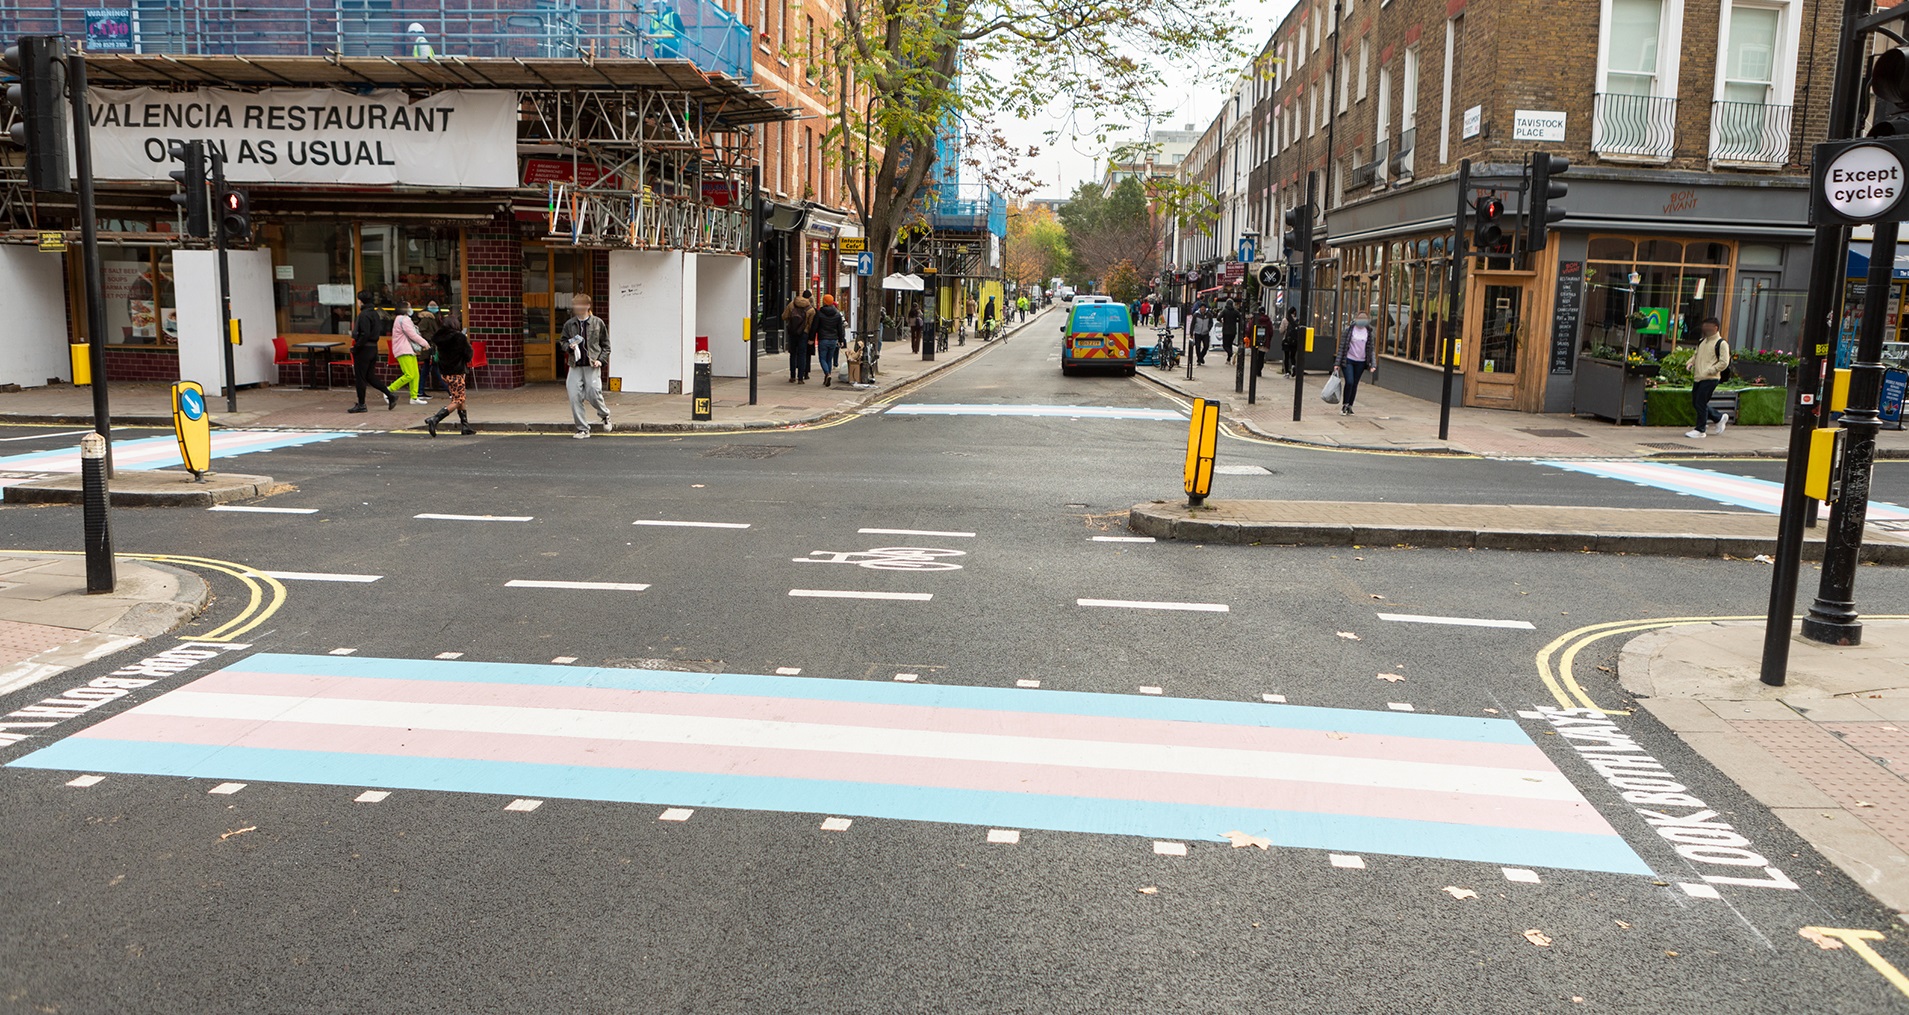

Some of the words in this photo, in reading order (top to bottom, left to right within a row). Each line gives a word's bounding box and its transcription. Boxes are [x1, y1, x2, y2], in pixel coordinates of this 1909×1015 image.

[88, 103, 233, 128] VALENCIA
[243, 104, 454, 132] RESTAURANT
[1517, 118, 1563, 128] TAVISTOCK
[1516, 128, 1544, 137] PLACE
[144, 137, 229, 164] OPN
[238, 139, 277, 165] AS
[288, 140, 395, 166] USUAL
[1833, 166, 1898, 183] Except
[1670, 190, 1695, 203] BON
[1835, 185, 1894, 203] cycles
[1663, 198, 1698, 214] VIVANT
[108, 642, 253, 678] LOOK
[1536, 705, 1646, 752] WAYS
[1578, 752, 1707, 807] BOTH
[1636, 807, 1801, 889] LOOK
